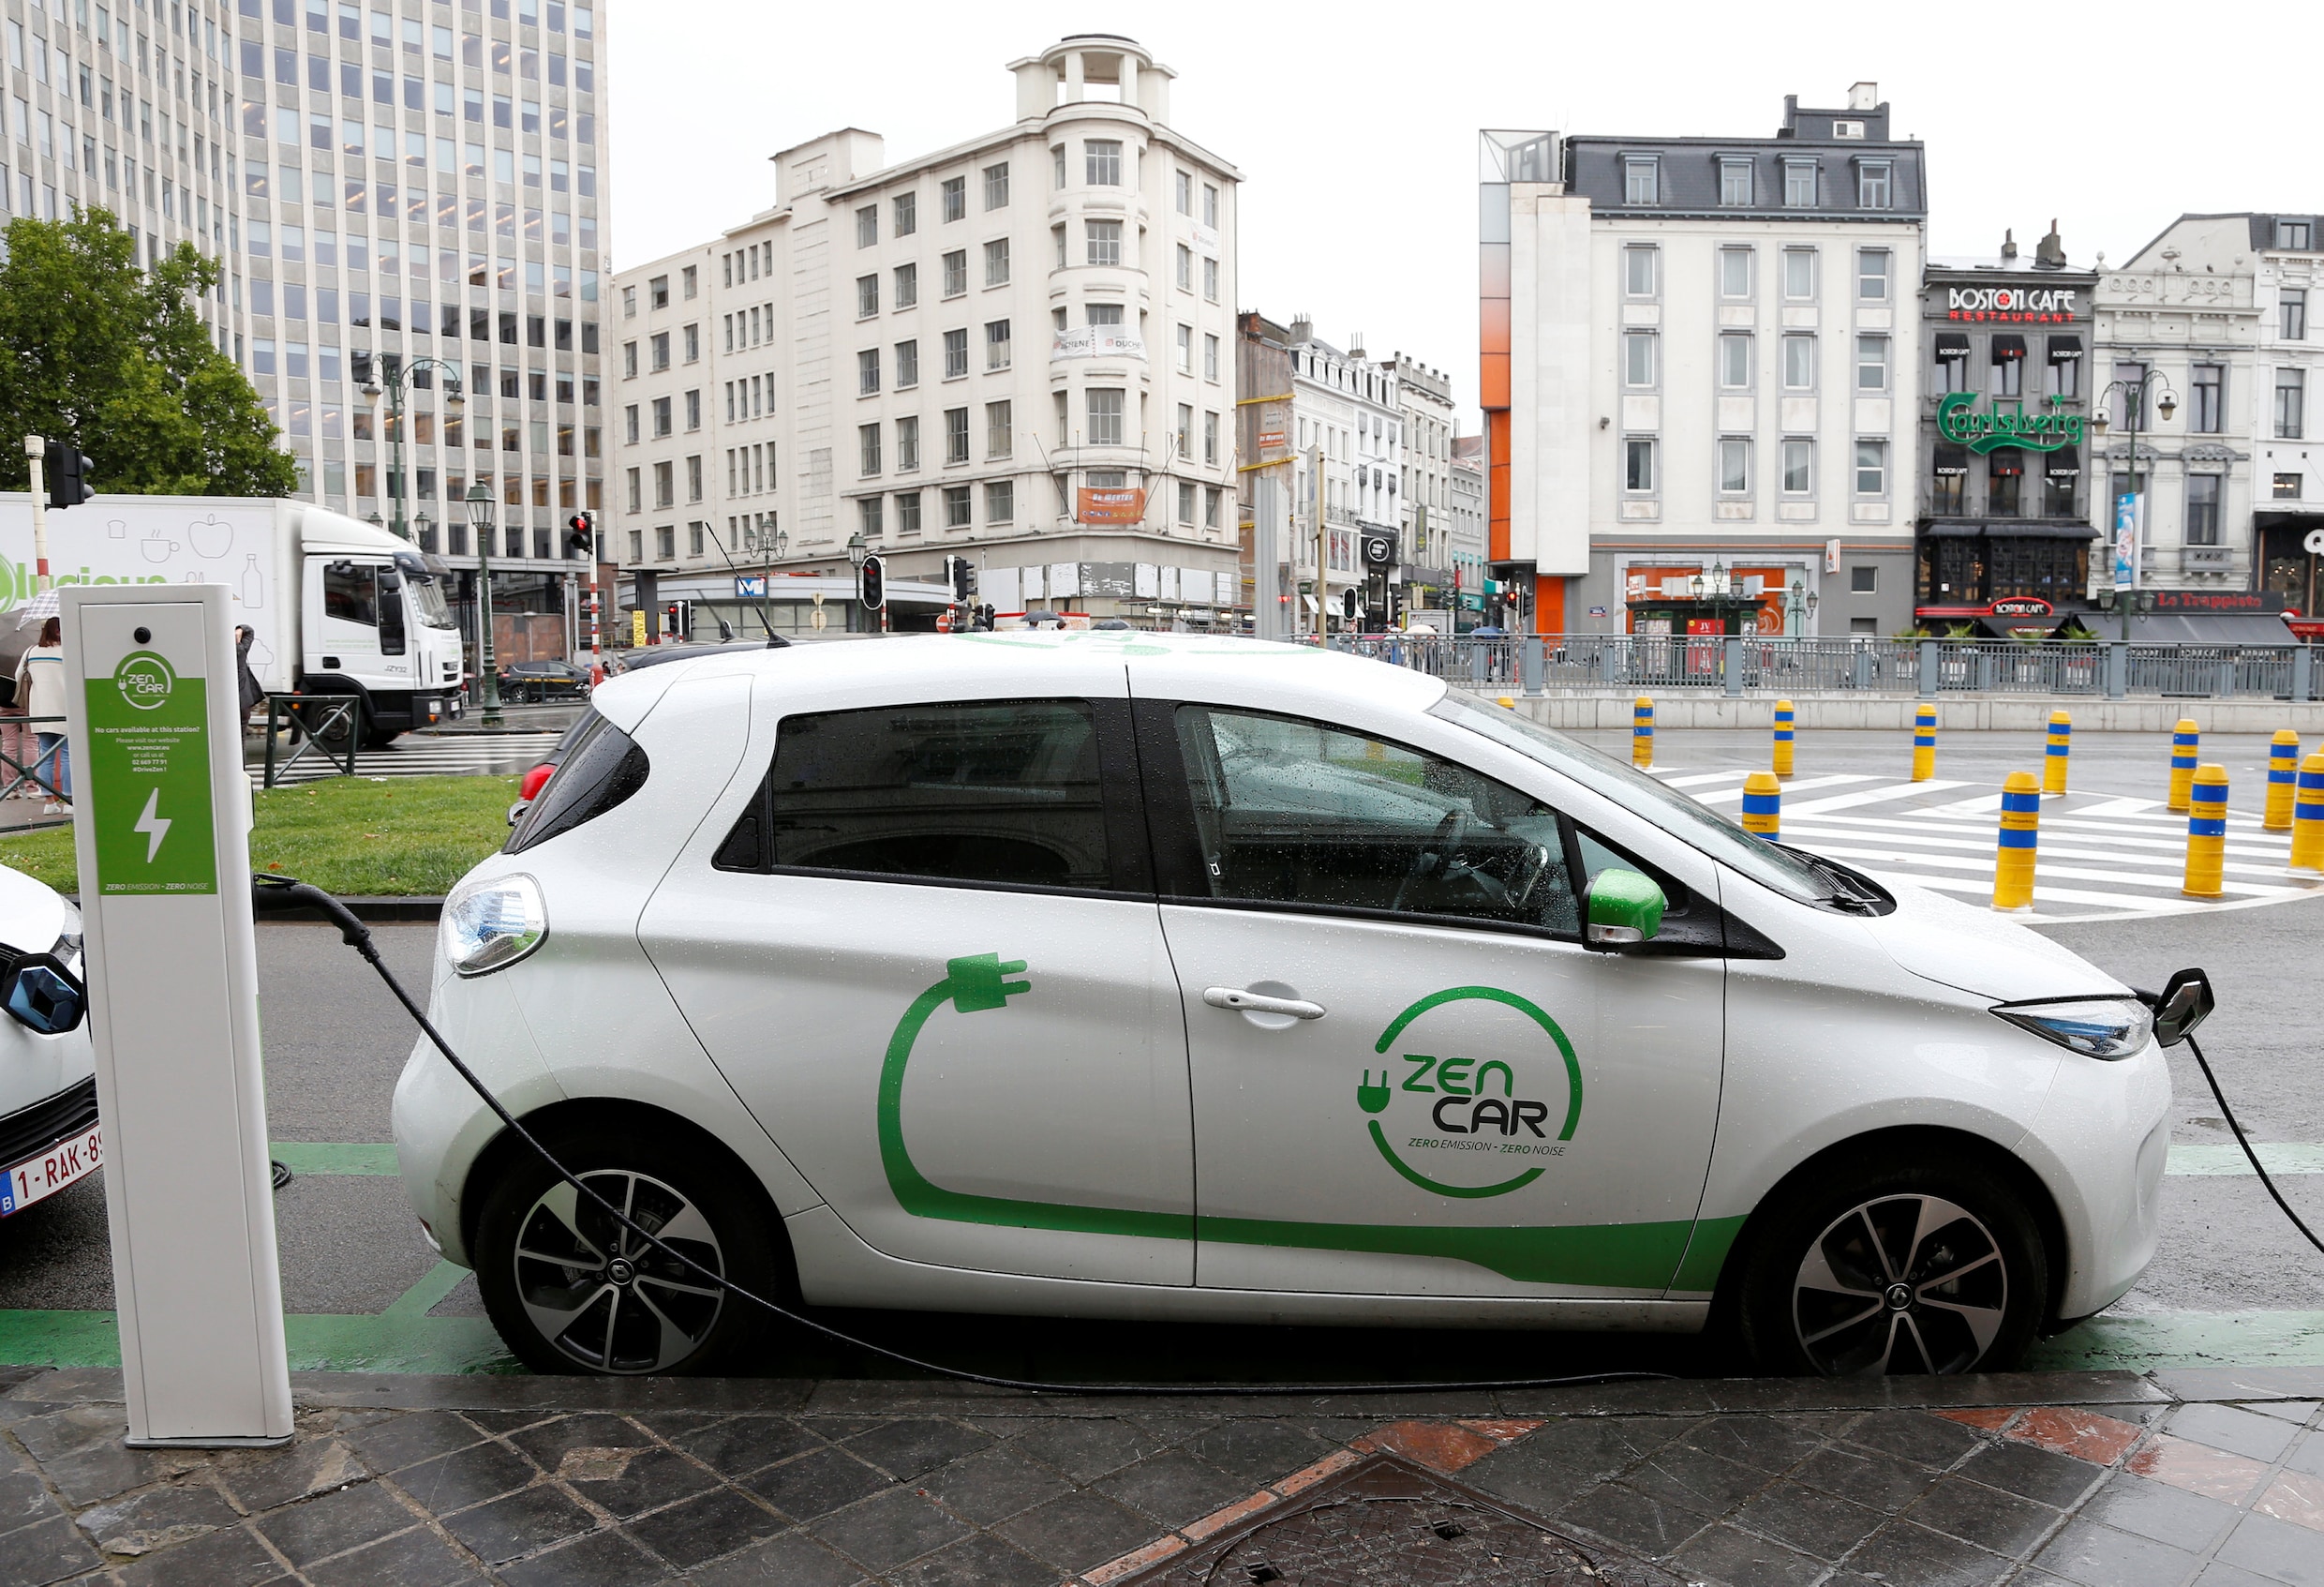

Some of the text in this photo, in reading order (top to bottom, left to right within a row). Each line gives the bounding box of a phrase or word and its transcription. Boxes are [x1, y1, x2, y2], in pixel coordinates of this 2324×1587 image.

[1949, 288, 2075, 311] BOSTON CAFE
[1949, 310, 2075, 322] RESTAURANT
[1937, 392, 2084, 445] Carlsberg
[2159, 592, 2263, 608] Le Trappiste
[1996, 604, 2025, 613] BOSTON
[127, 674, 155, 684] ZEN
[136, 683, 165, 694] CAR
[165, 882, 186, 891] ZERO
[1402, 1055, 1513, 1098] ZEN
[1432, 1096, 1548, 1138] CAR
[1408, 1137, 1439, 1148] ZERO
[1440, 1139, 1492, 1151] EMISSION
[1499, 1144, 1531, 1154] ZERO
[1532, 1145, 1566, 1157] NOISE
[2, 1196, 12, 1211] B
